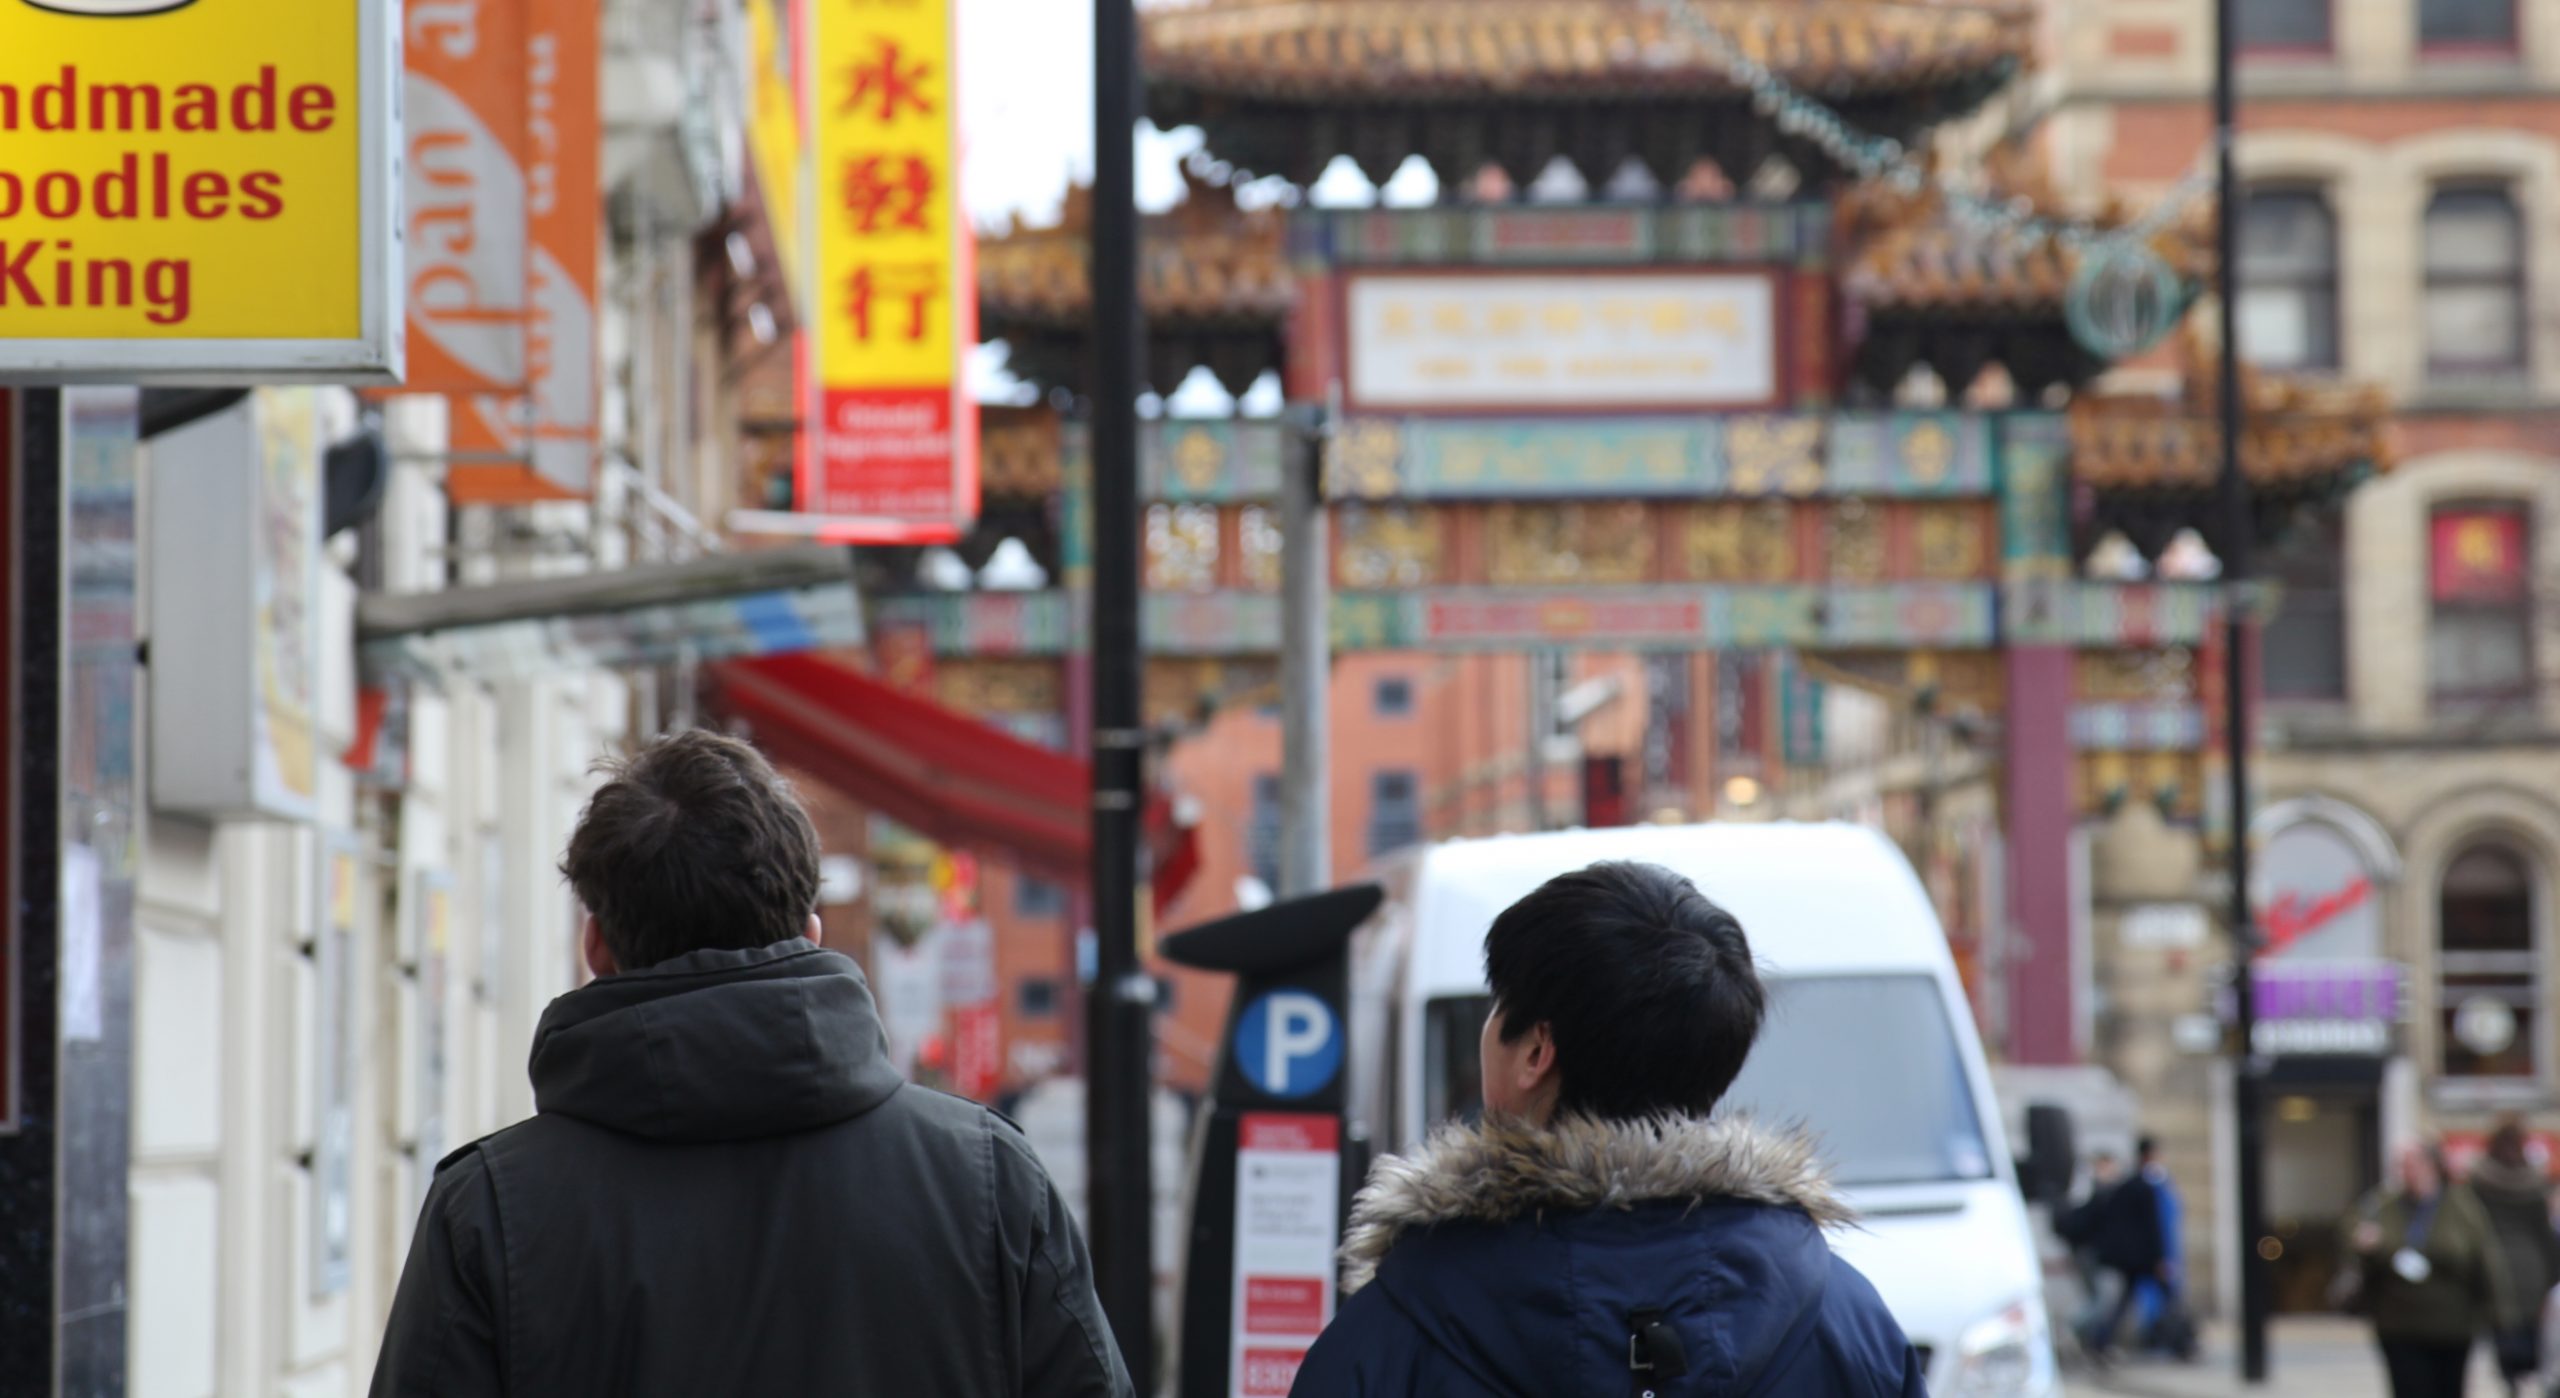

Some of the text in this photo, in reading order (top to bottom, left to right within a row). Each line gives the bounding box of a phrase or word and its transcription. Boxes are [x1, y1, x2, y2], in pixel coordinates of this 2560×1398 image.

[838, 0, 943, 347] 永發行
[0, 240, 191, 325] King
[1264, 994, 1331, 1092] P
